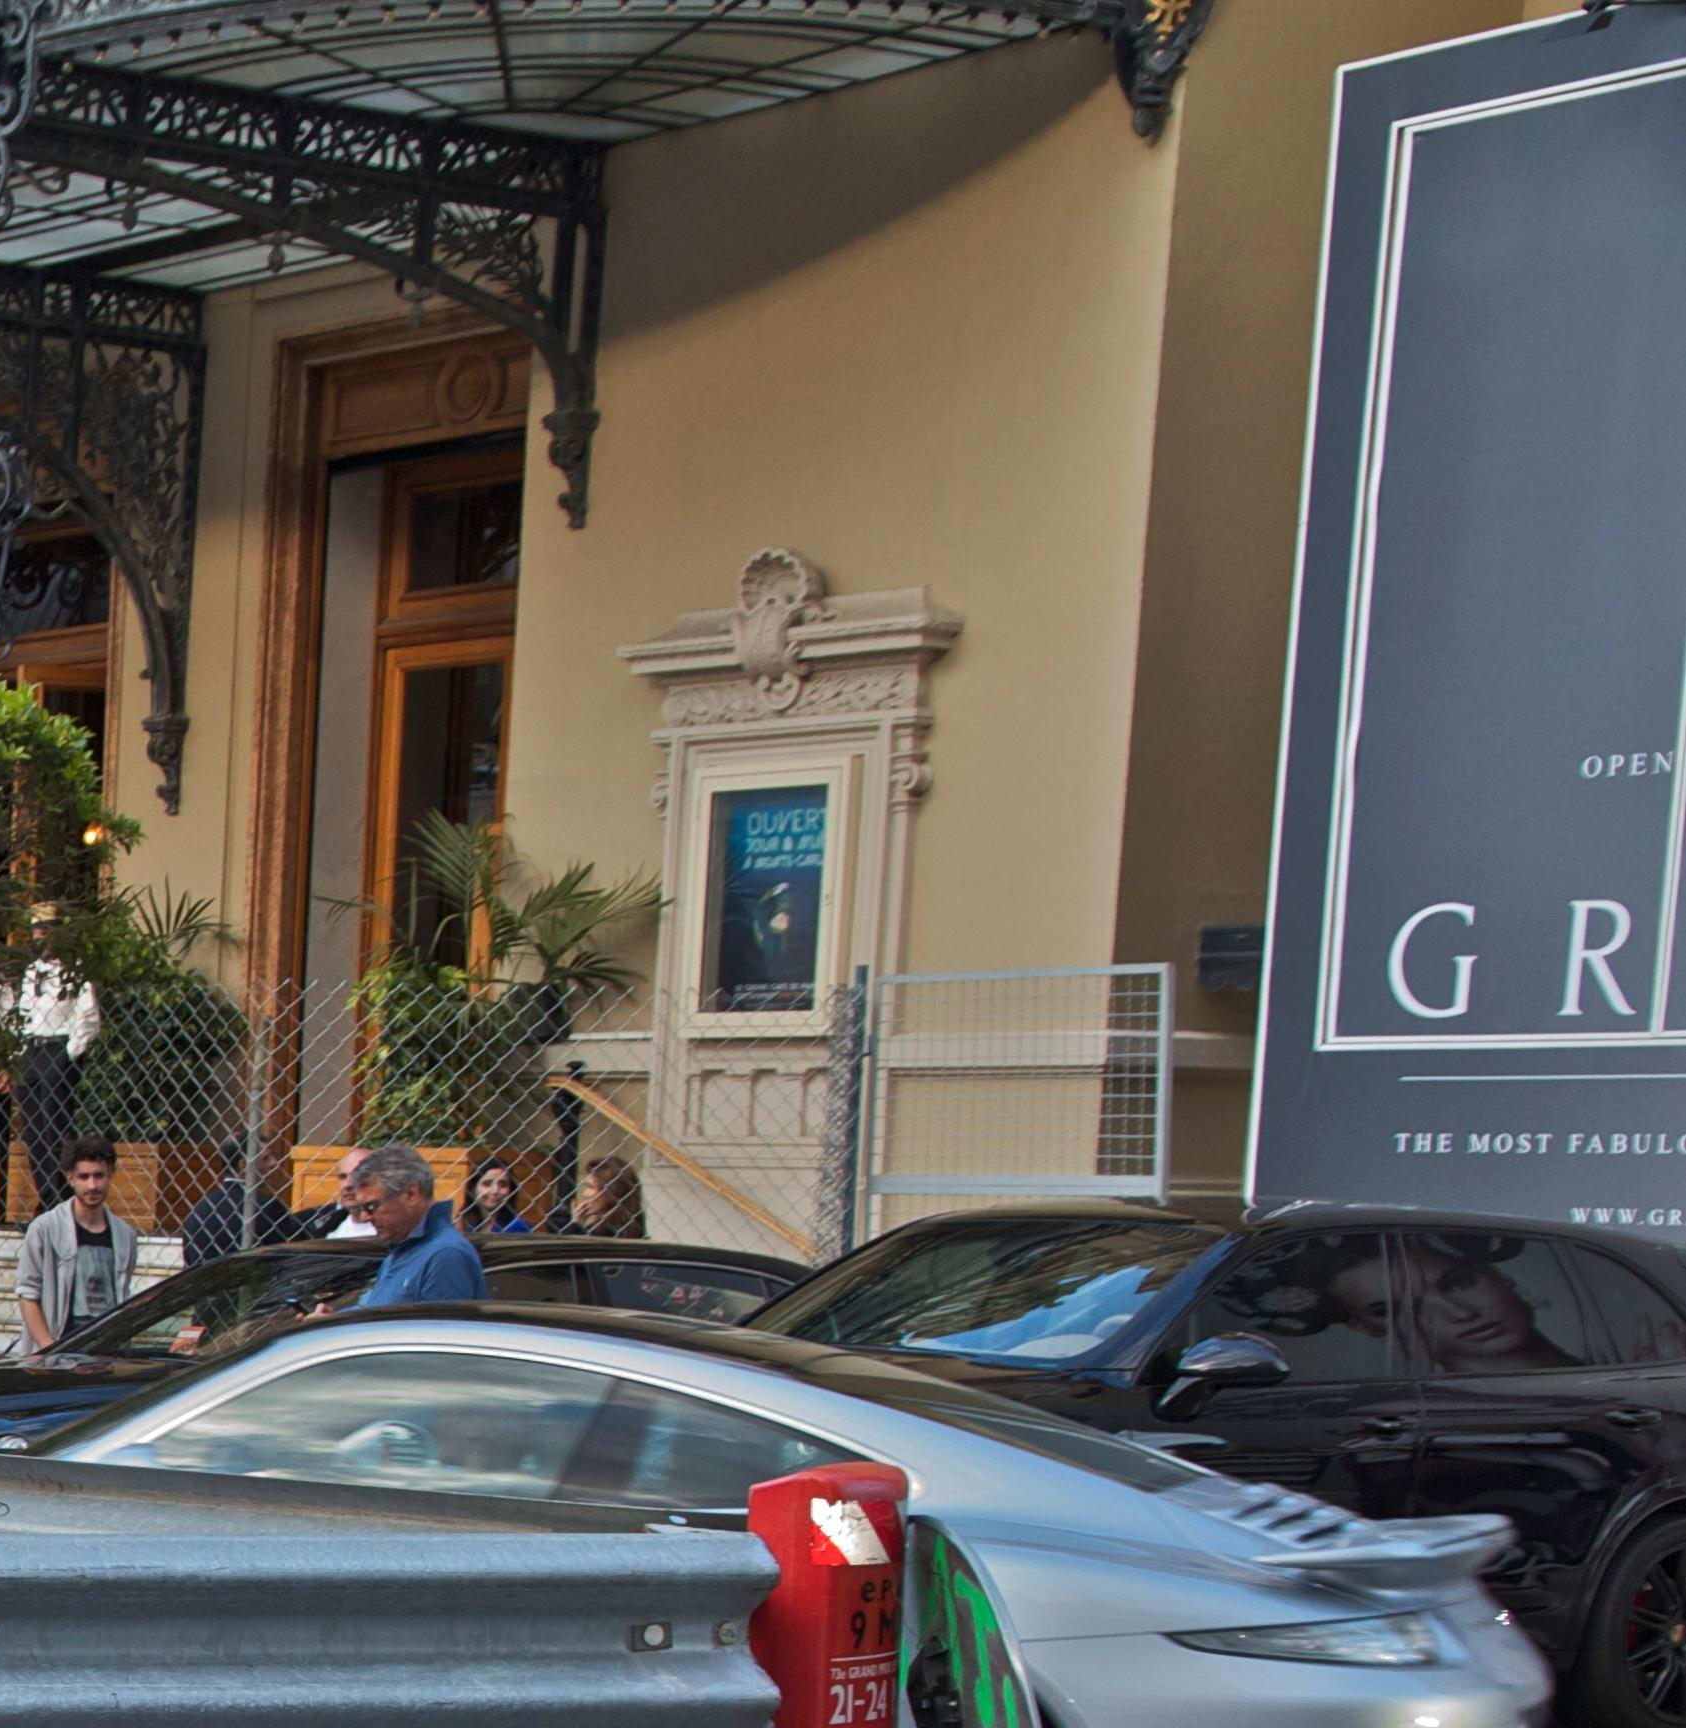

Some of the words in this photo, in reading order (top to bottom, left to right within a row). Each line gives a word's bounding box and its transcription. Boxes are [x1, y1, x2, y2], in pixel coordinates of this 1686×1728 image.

[1393, 1132, 1454, 1154] THE
[1467, 1132, 1553, 1155] MOST
[1570, 1206, 1686, 1227] WWW.GR
[829, 1679, 888, 1725] 21-24
